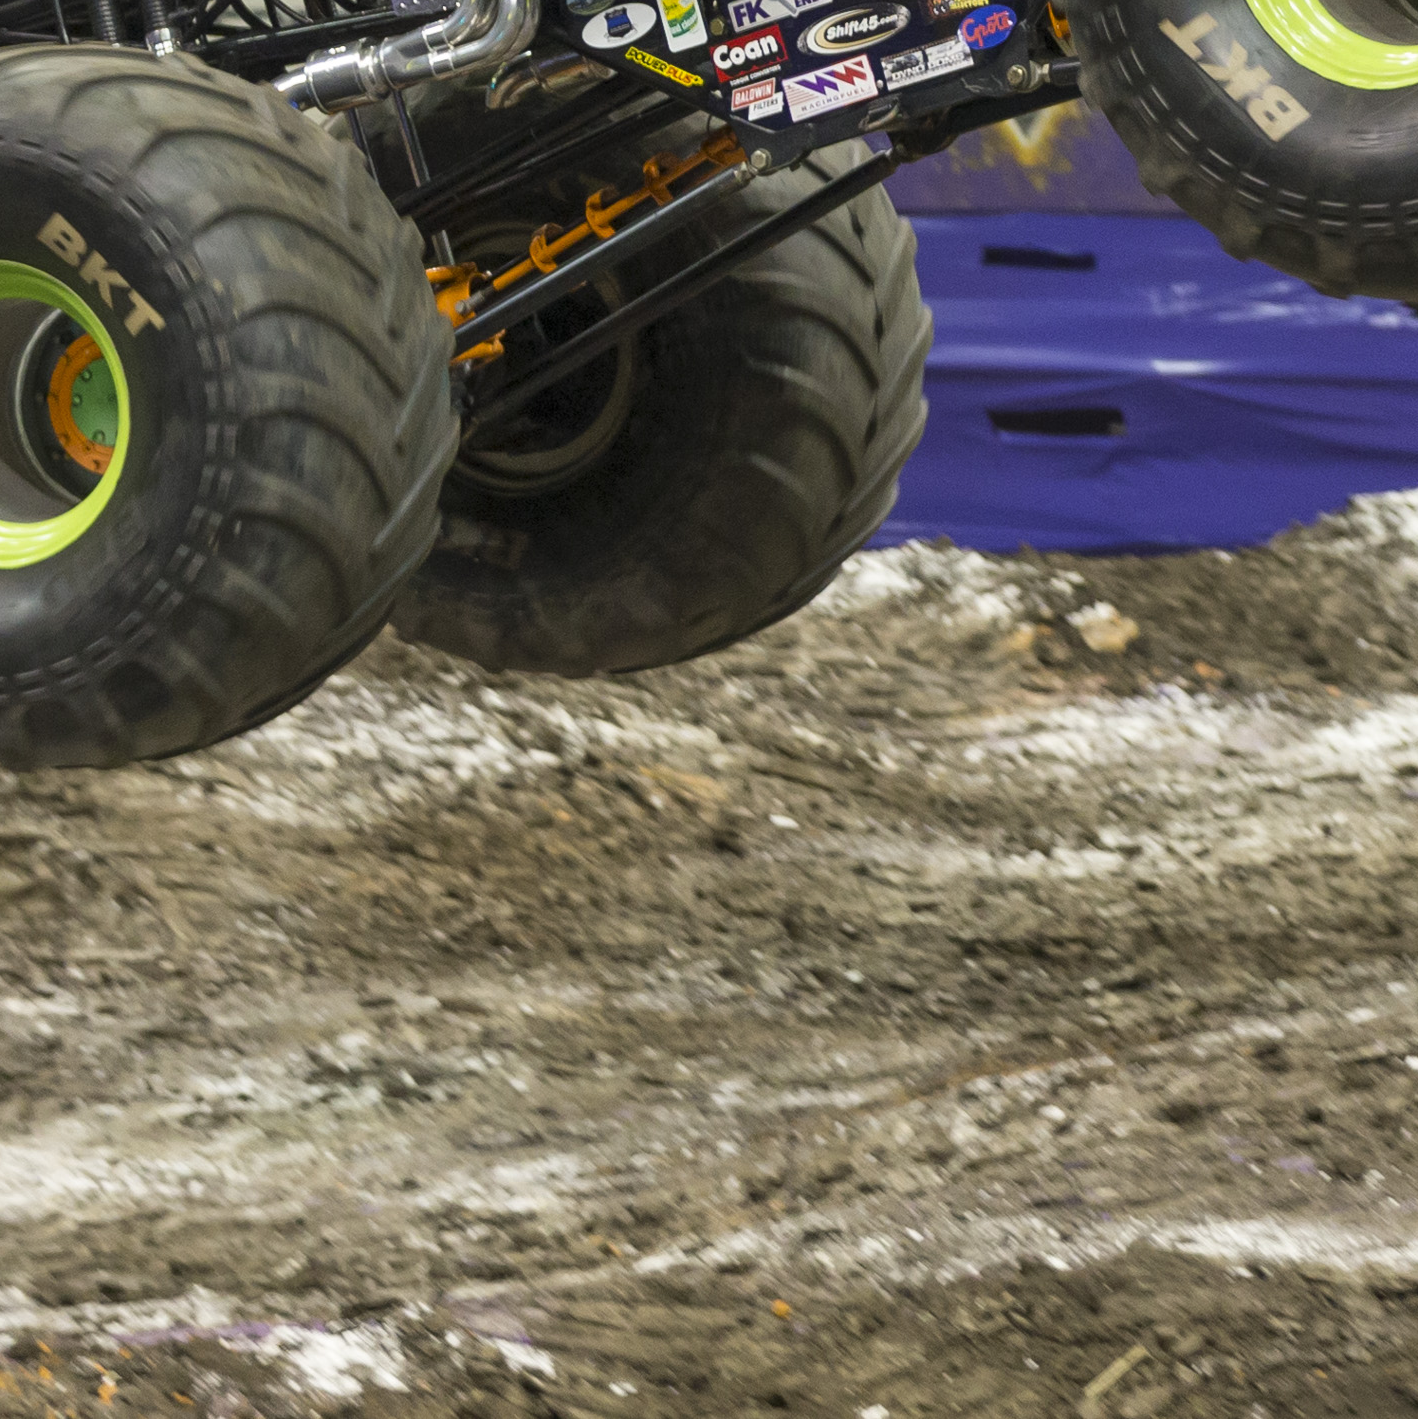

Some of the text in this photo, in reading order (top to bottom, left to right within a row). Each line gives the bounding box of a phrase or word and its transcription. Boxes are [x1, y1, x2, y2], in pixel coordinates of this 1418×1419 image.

[826, 13, 899, 41] Shift45.com
[627, 47, 693, 86] POWER PLUS
[713, 34, 779, 70] Coan
[734, 82, 773, 106] BALDWIN
[1158, 11, 1311, 142] BKT
[753, 98, 780, 112] FILTERS
[36, 211, 167, 337] BKT
